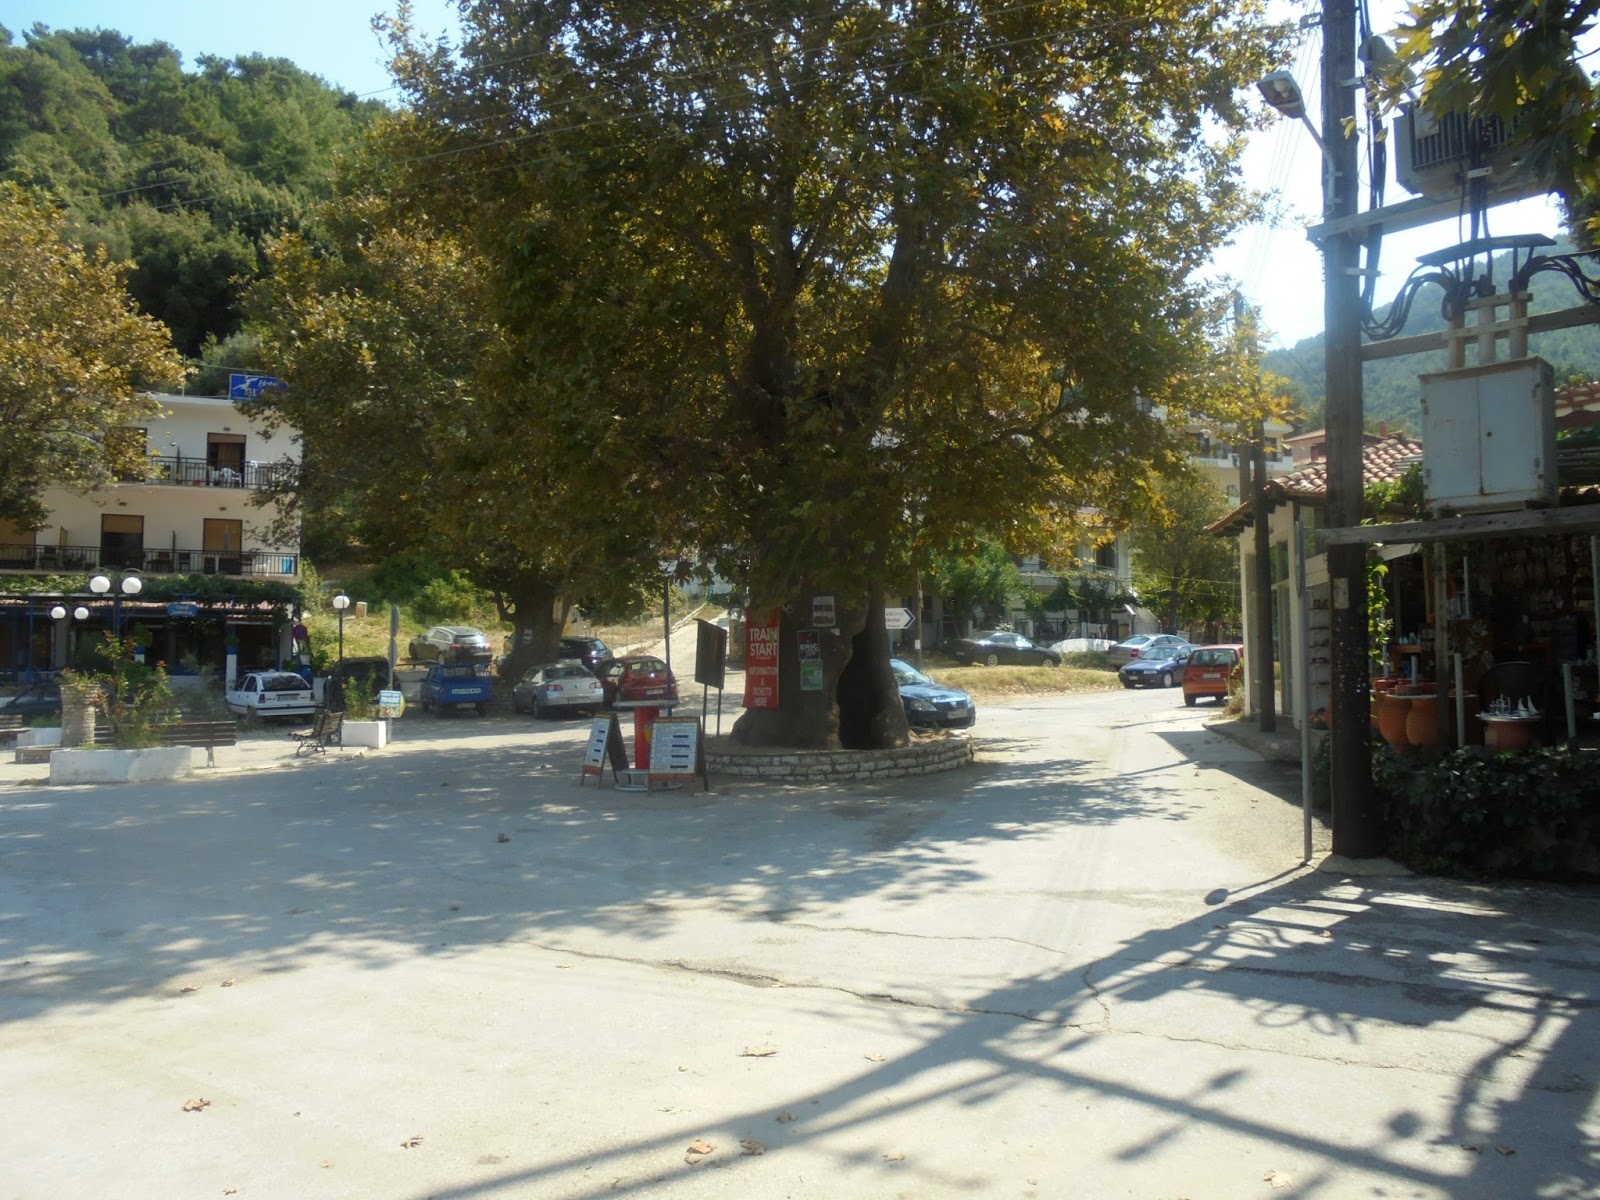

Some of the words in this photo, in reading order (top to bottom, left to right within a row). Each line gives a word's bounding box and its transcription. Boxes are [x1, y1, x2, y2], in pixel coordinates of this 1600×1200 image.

[749, 628, 777, 641] TRAIN
[750, 642, 777, 656] START
[799, 643, 819, 651] ERIC
